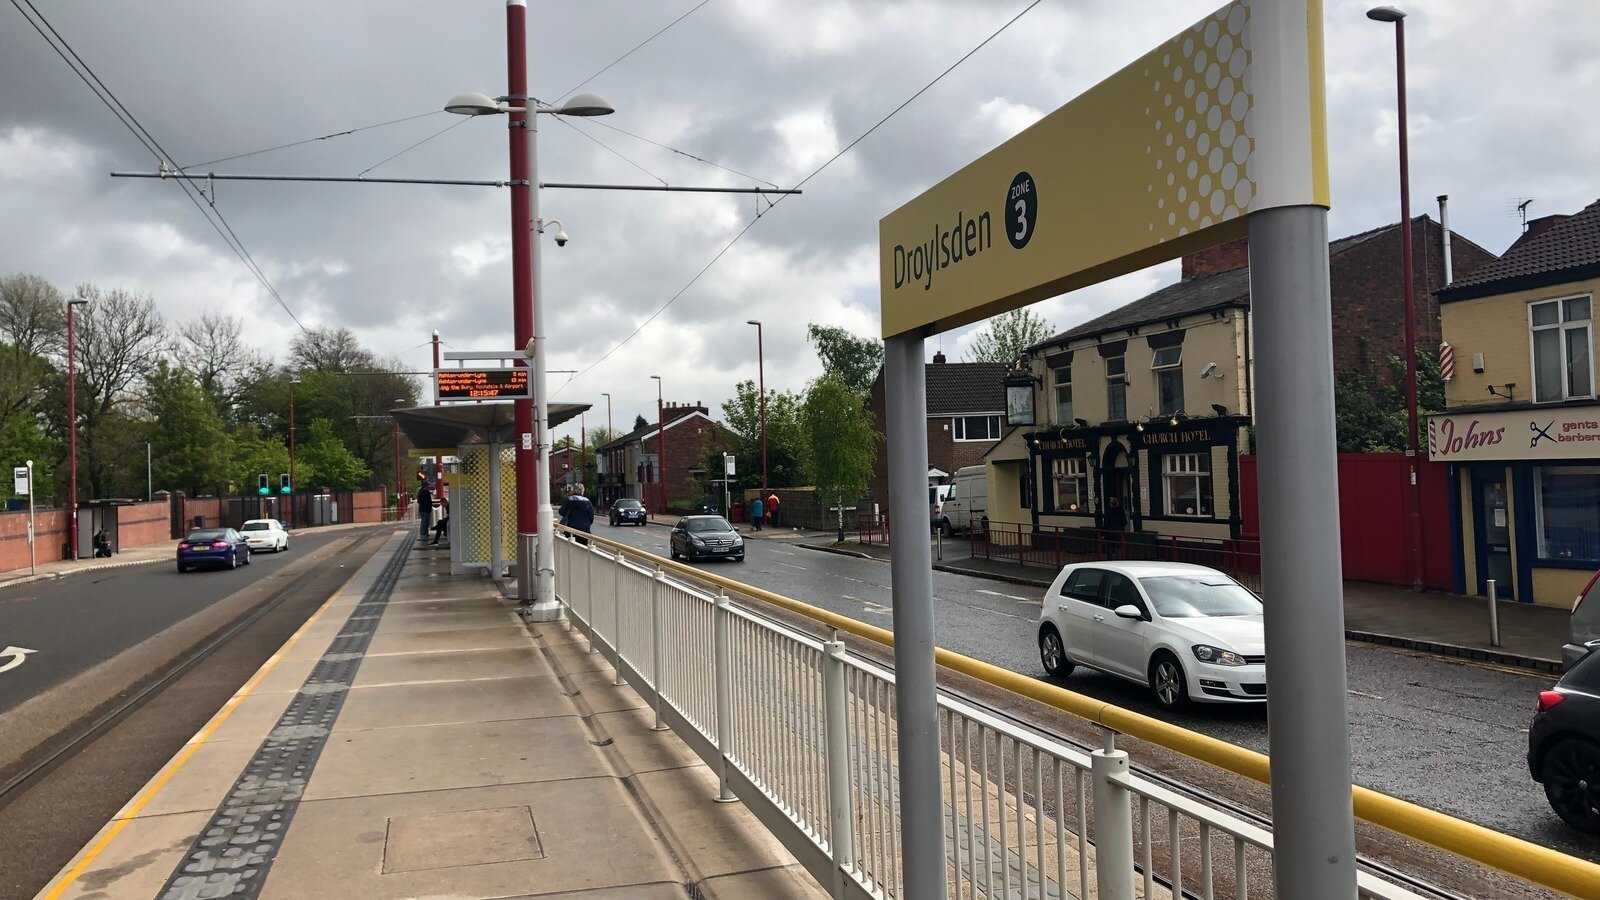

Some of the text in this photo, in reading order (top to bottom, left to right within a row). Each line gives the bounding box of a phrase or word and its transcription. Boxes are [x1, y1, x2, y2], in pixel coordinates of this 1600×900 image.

[1011, 179, 1030, 200] ZONE
[1014, 199, 1028, 241] 3
[893, 211, 992, 291] Droylsden
[1142, 429, 1211, 444] CHURCH HOTEL
[1439, 418, 1506, 455] Johns
[1562, 420, 1599, 432] gents
[1038, 438, 1087, 450] CHURCH HOTEL
